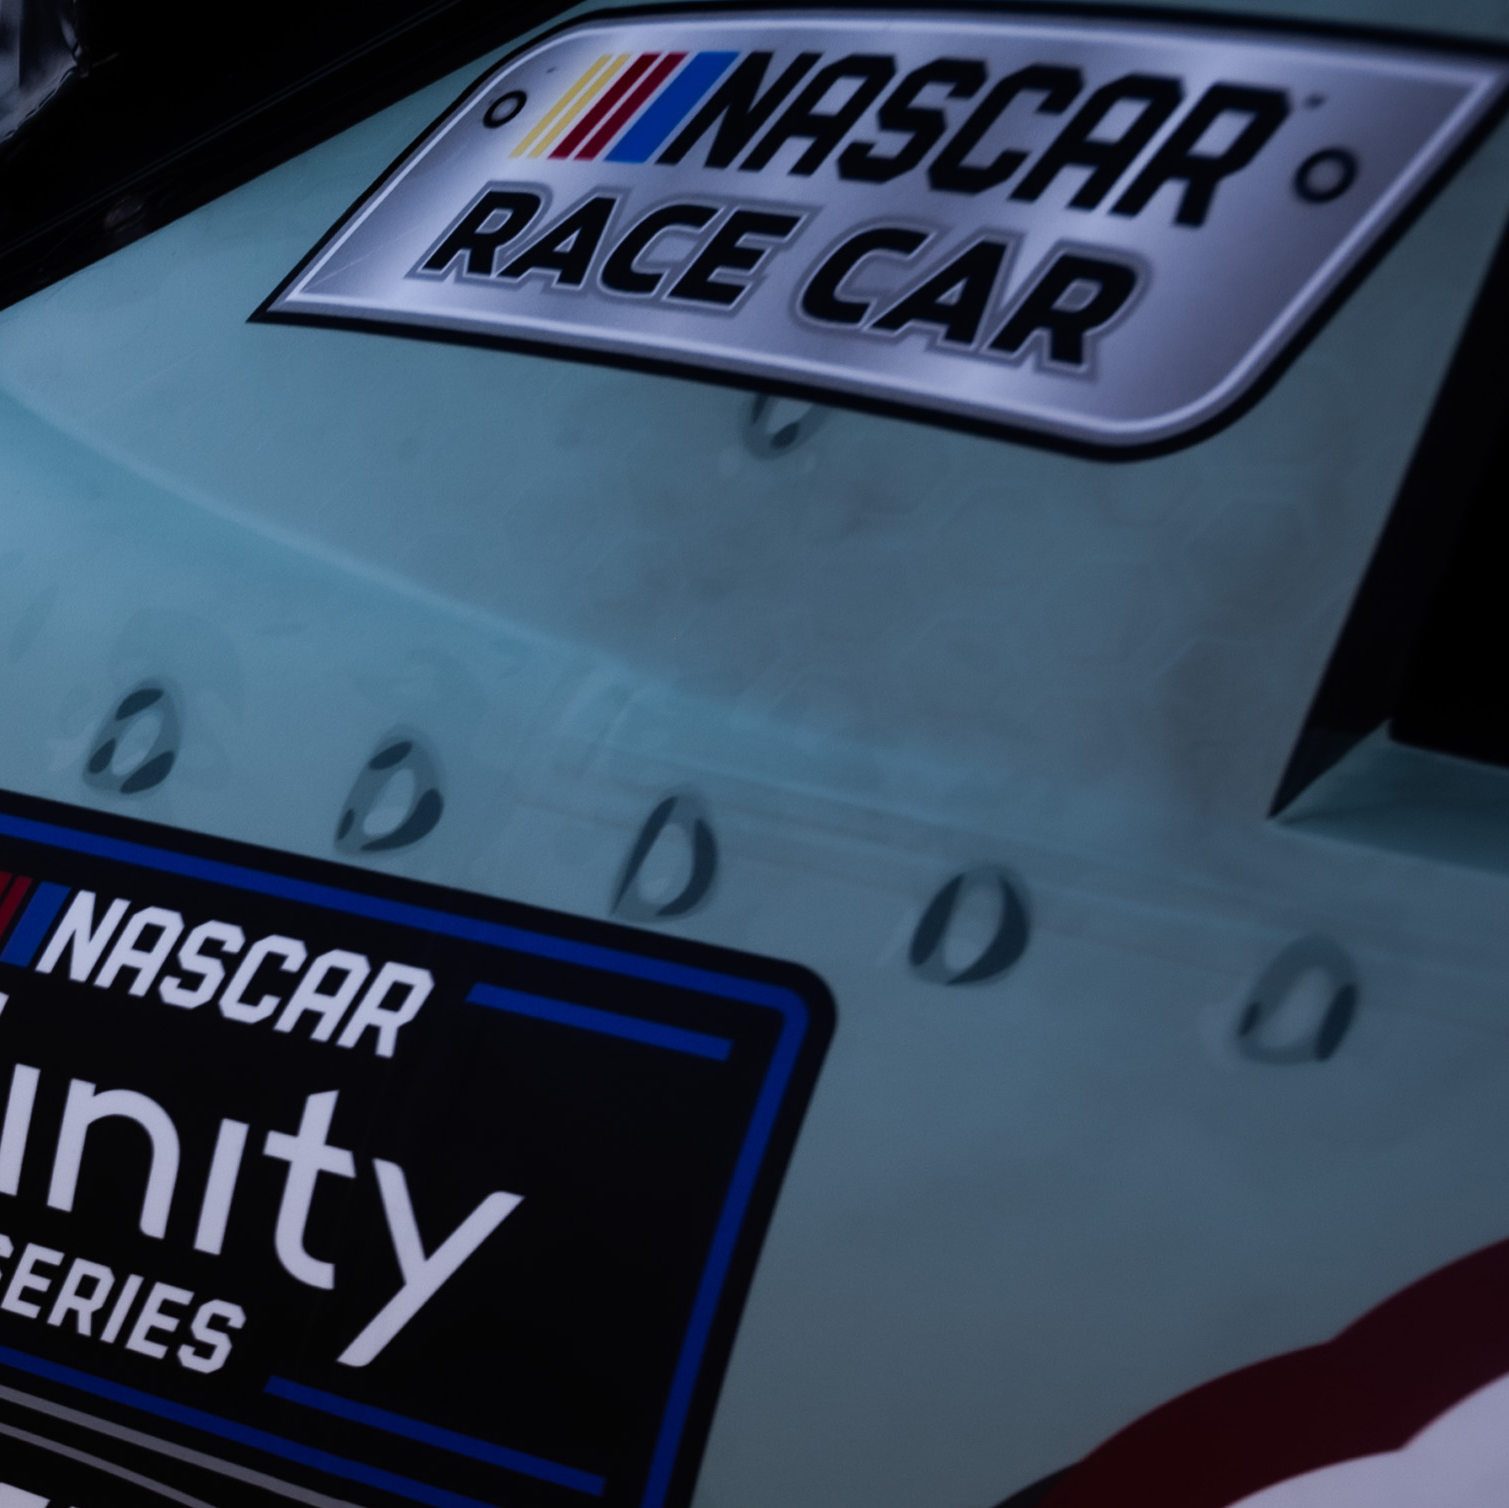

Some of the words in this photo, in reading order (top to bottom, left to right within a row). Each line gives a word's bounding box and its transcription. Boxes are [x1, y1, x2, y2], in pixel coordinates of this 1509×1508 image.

[657, 50, 1292, 229] NASCAR
[421, 190, 803, 307] RACE
[798, 227, 1140, 368] CAR
[35, 889, 435, 1058] NASCAR
